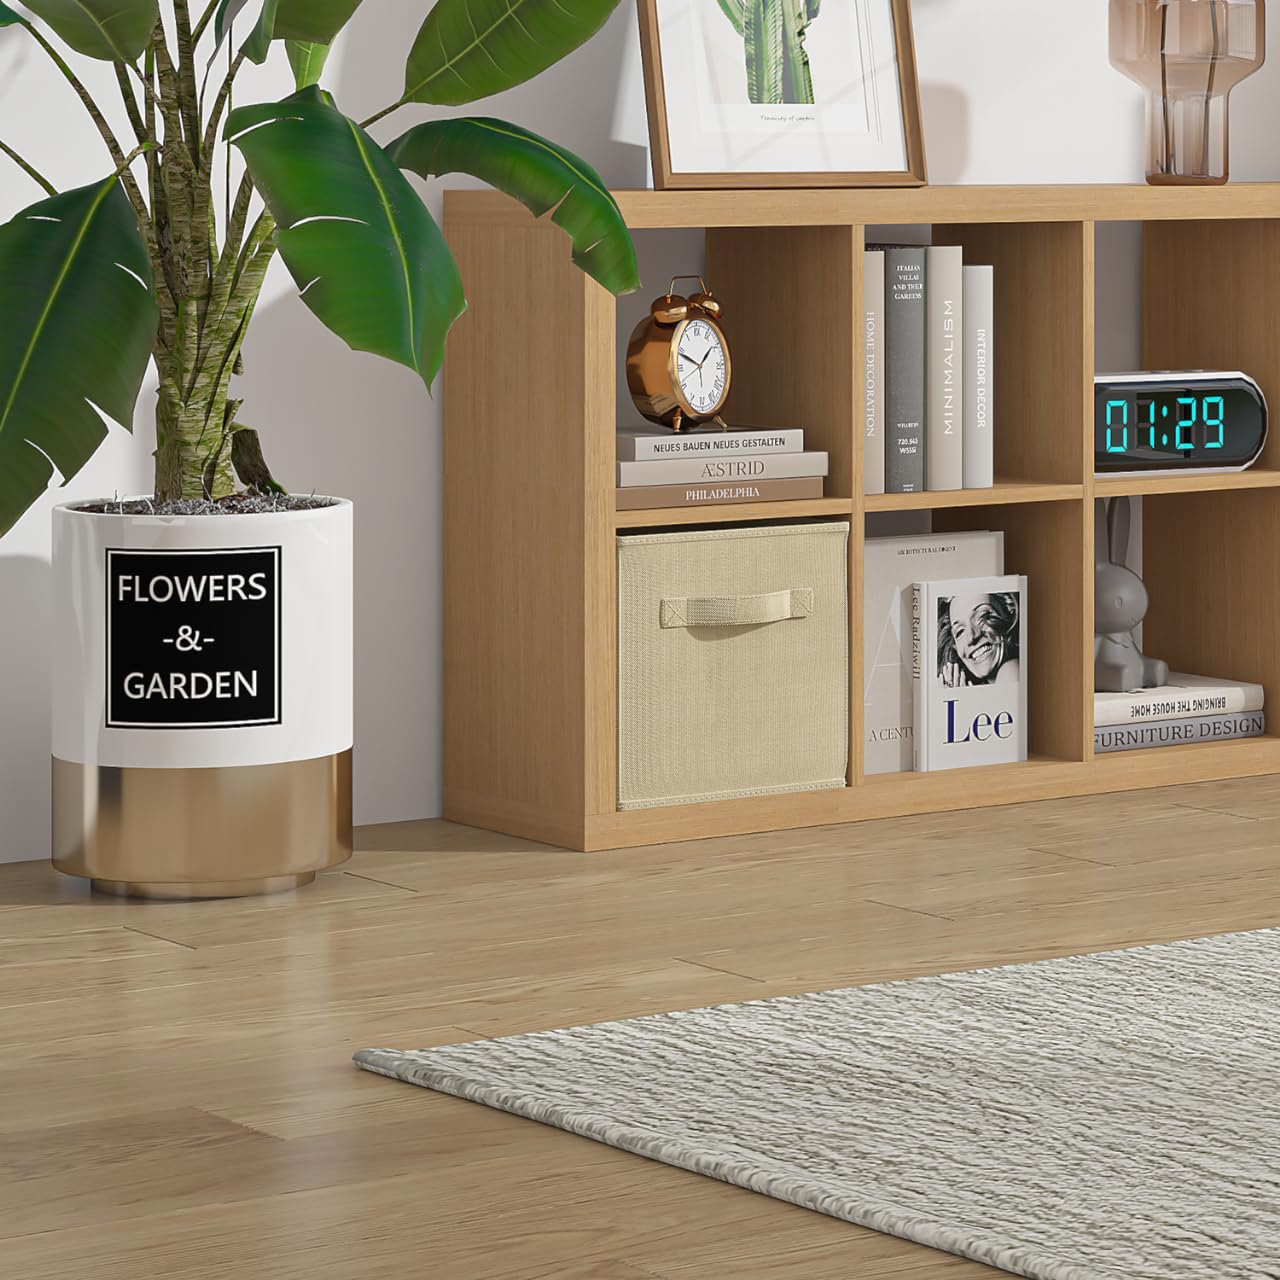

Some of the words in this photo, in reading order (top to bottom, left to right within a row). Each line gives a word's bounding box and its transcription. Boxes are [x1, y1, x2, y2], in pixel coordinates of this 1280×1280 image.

[866, 311, 875, 350] HOME
[943, 300, 953, 435] MINIMALISM
[977, 329, 986, 385] INTERIOR
[866, 354, 875, 437] DECORATION
[977, 388, 986, 428] DECOR
[1106, 396, 1224, 453] 01:29
[653, 442, 681, 453] NEUES
[682, 441, 711, 452] BAUEN
[713, 439, 740, 450] NEUES
[742, 437, 785, 448] GESTALTEN
[686, 487, 760, 500] PHILADELPHIA
[118, 573, 267, 602] FLOWERS
[912, 587, 921, 611] Lee
[912, 616, 921, 680] Radziwill
[123, 670, 258, 699] GARDEN
[1131, 704, 1151, 717] HOME
[1153, 701, 1176, 714] HOUSE
[1177, 700, 1191, 712] THE
[1193, 696, 1226, 711] BRINGING
[869, 730, 878, 742] A
[943, 699, 1013, 744] Lee
[1200, 717, 1263, 737] DESIGN
